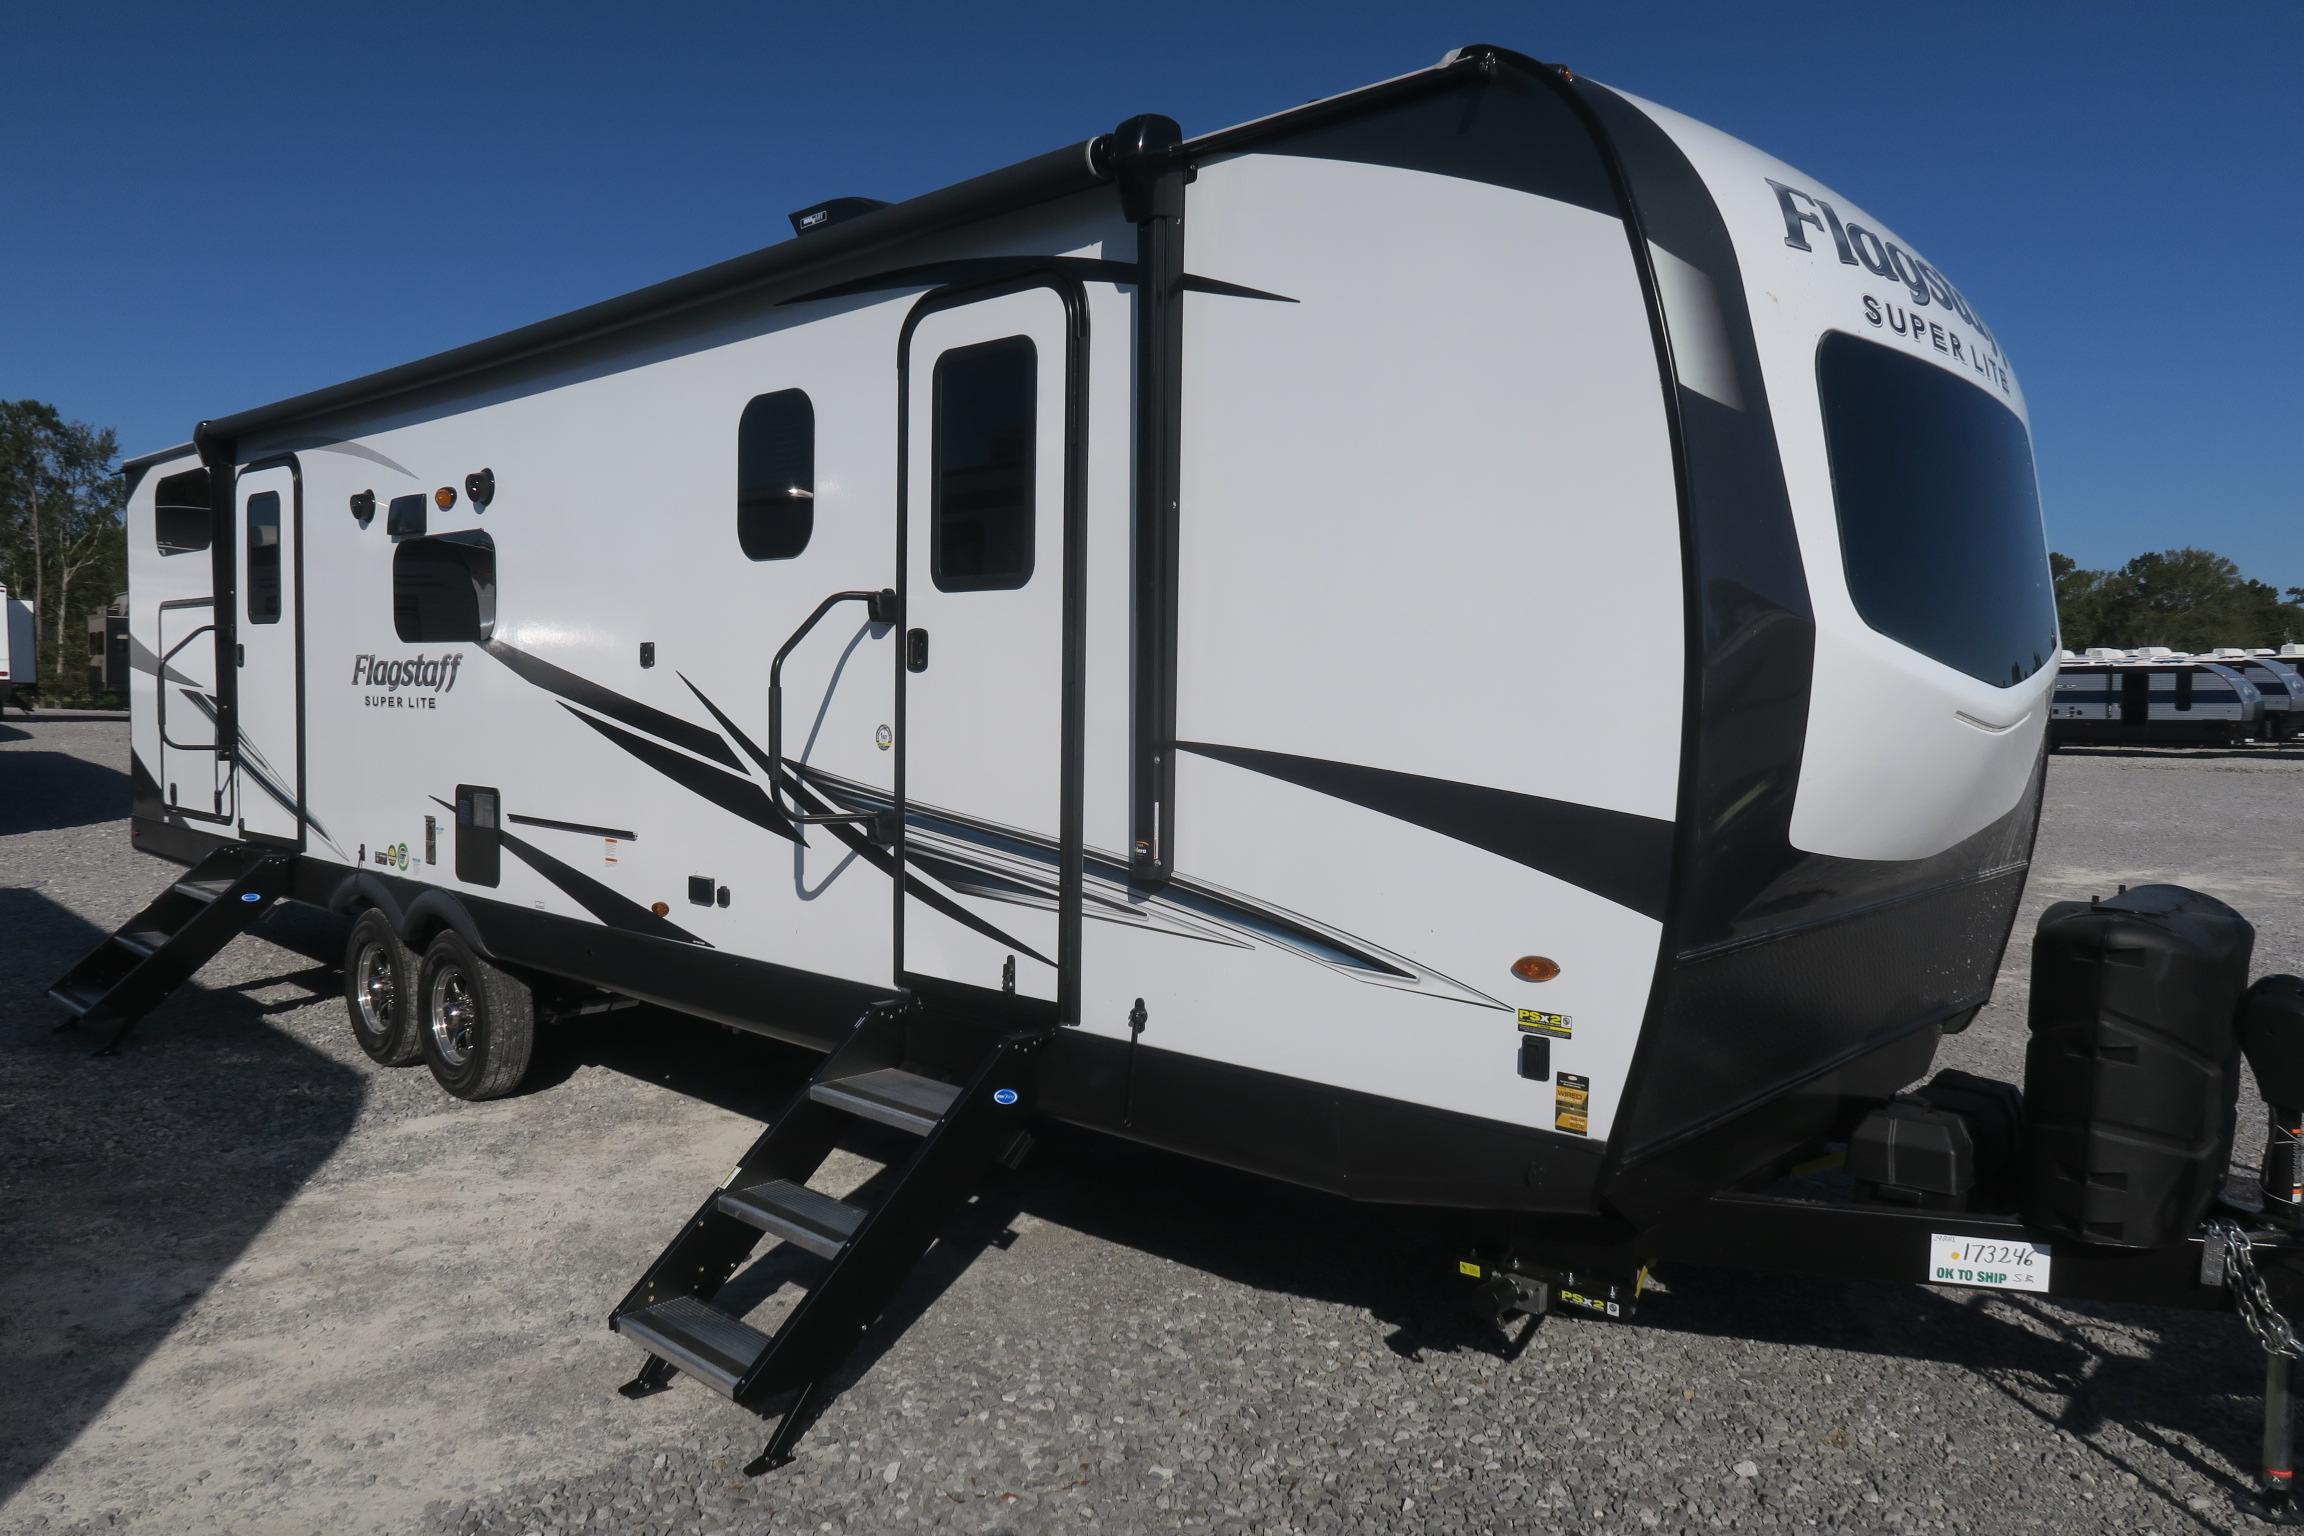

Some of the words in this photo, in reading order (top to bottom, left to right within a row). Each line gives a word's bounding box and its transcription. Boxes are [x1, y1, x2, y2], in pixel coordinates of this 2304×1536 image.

[1862, 293, 1967, 365] SUPER
[1970, 345, 2010, 396] LITE
[351, 652, 464, 693] Flagstaff
[364, 695, 404, 708] SUPER
[408, 697, 436, 709] LITE
[1519, 1009, 1561, 1025] PSx2
[1963, 1242, 2036, 1267] 173246
[1936, 1267, 1954, 1279] OK
[1958, 1269, 1973, 1281] TO
[1976, 1271, 2007, 1284] SHIP
[1561, 1289, 1605, 1311] PSx2
